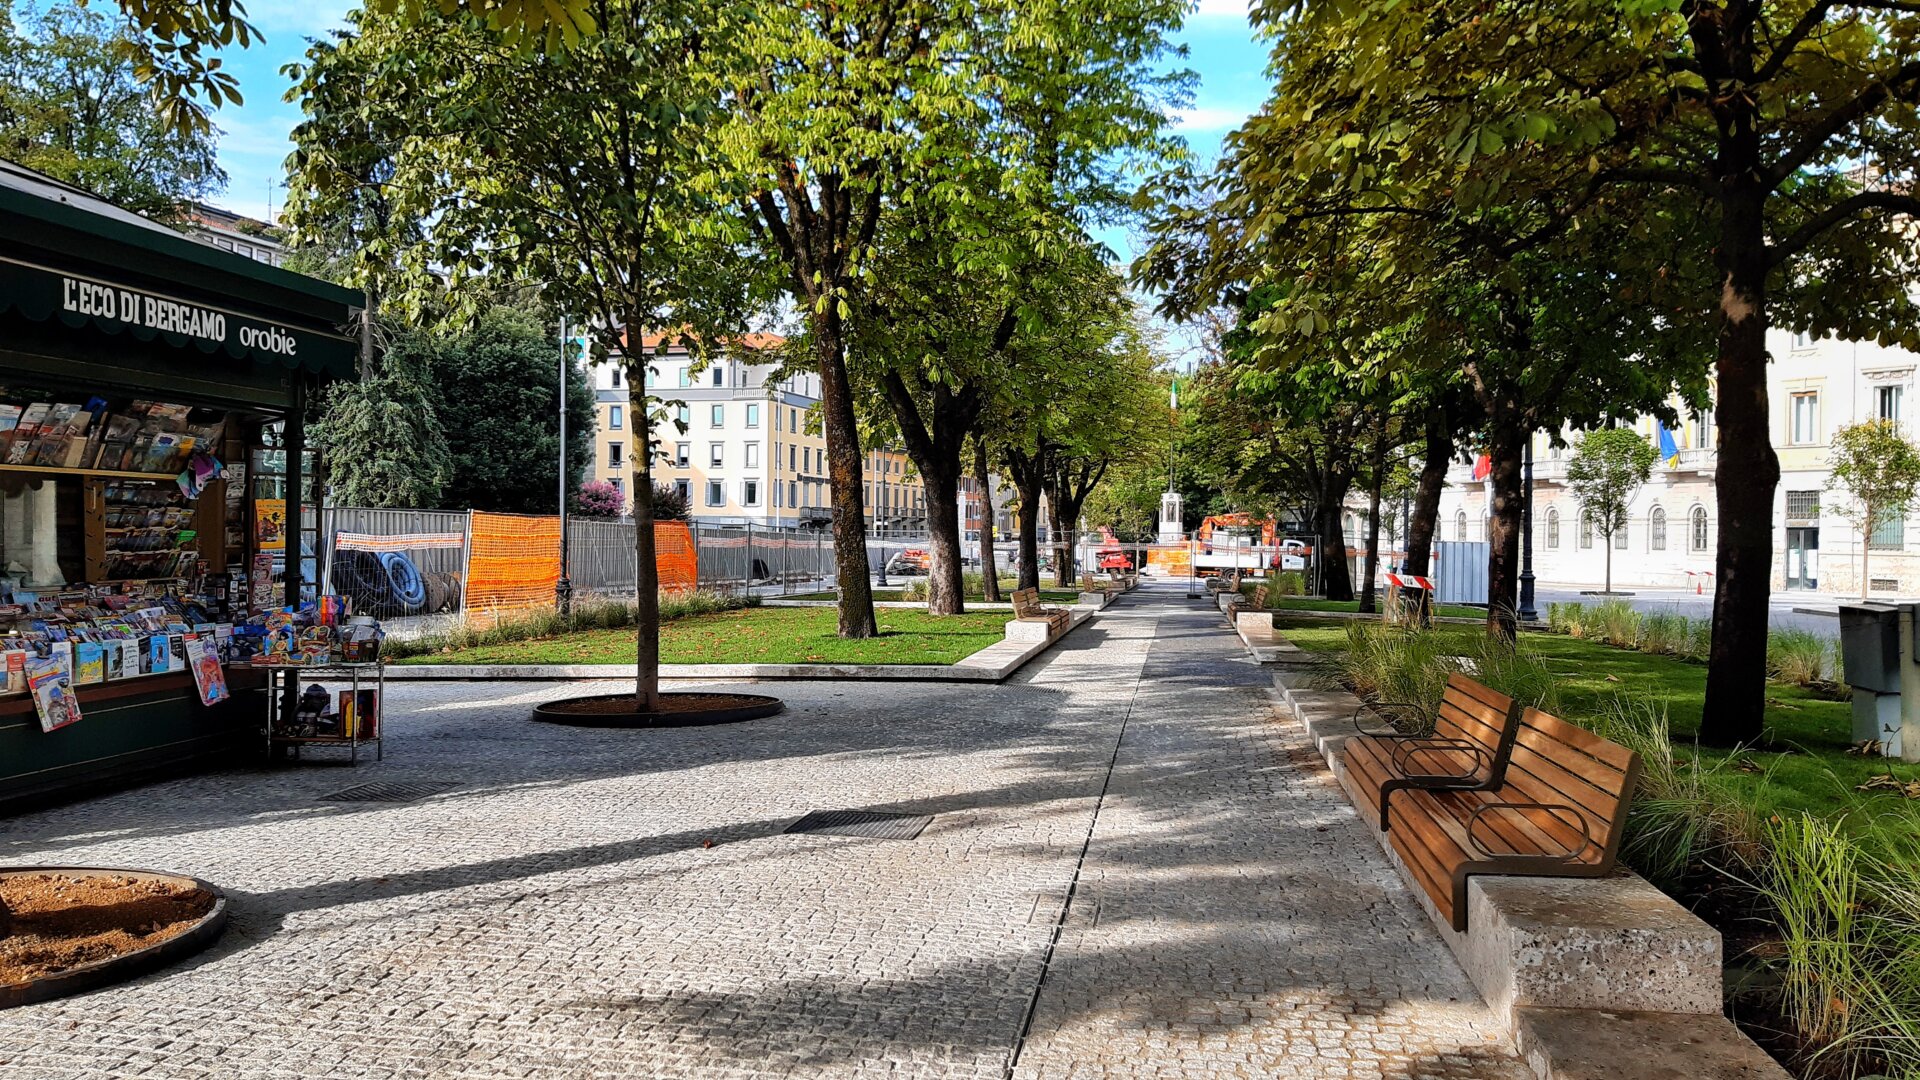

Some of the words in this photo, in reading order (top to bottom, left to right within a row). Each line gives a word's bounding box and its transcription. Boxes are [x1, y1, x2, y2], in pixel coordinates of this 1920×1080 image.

[63, 277, 116, 319] L'ECO
[120, 290, 141, 325] DI
[144, 296, 226, 342] BERGAMO
[240, 326, 297, 356] orobie
